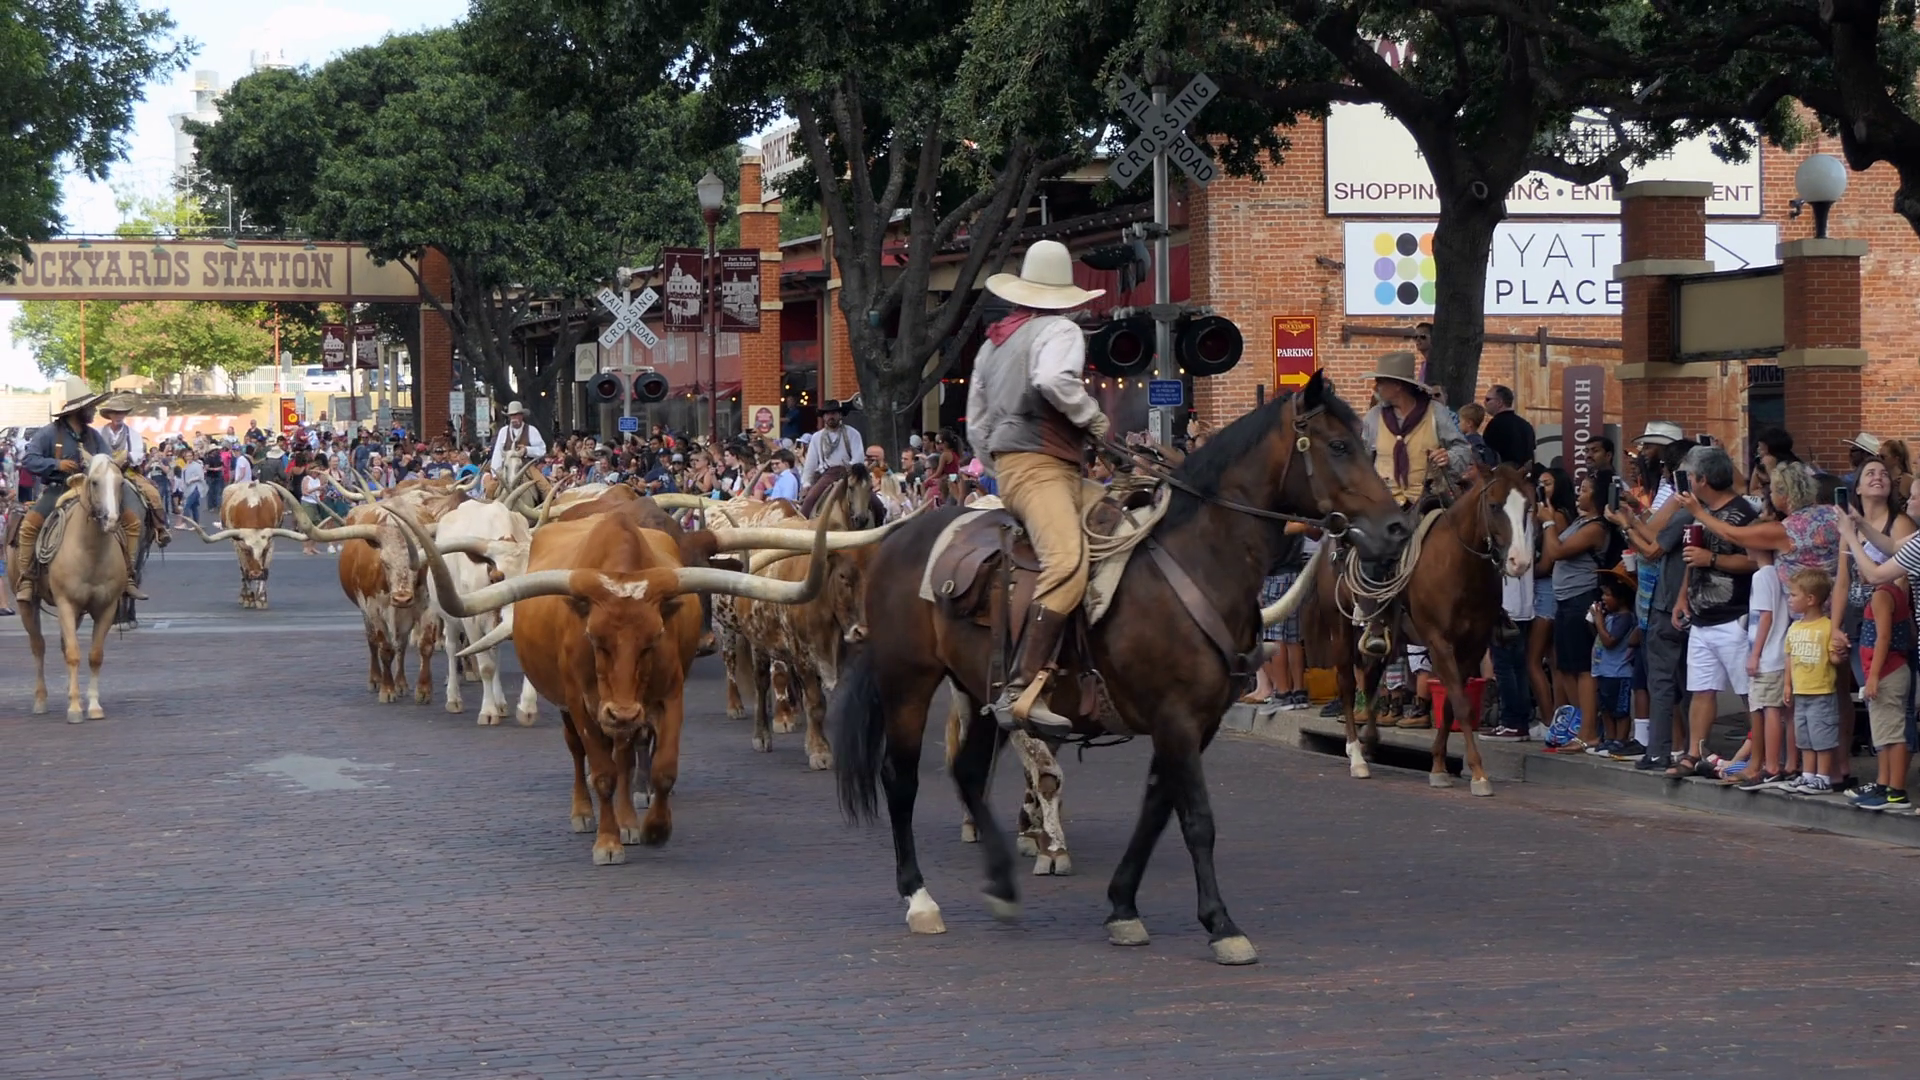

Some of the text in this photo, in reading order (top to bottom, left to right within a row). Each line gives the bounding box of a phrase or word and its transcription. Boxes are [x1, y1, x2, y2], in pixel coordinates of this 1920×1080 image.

[1116, 82, 1209, 178] CROSSING
[1168, 136, 1213, 182] ROAD
[1333, 182, 1440, 201] SHOPPIN
[1505, 184, 1550, 201] ING
[14, 251, 334, 288] OCKYARDS STATION
[600, 290, 623, 315] RAIL
[1495, 279, 1623, 305] PLACE
[604, 292, 654, 344] CROSSING
[631, 321, 656, 346] ROAD
[1276, 348, 1314, 358] PARKING
[130, 415, 239, 433] WIFT
[1574, 379, 1591, 479] HISTORIC
